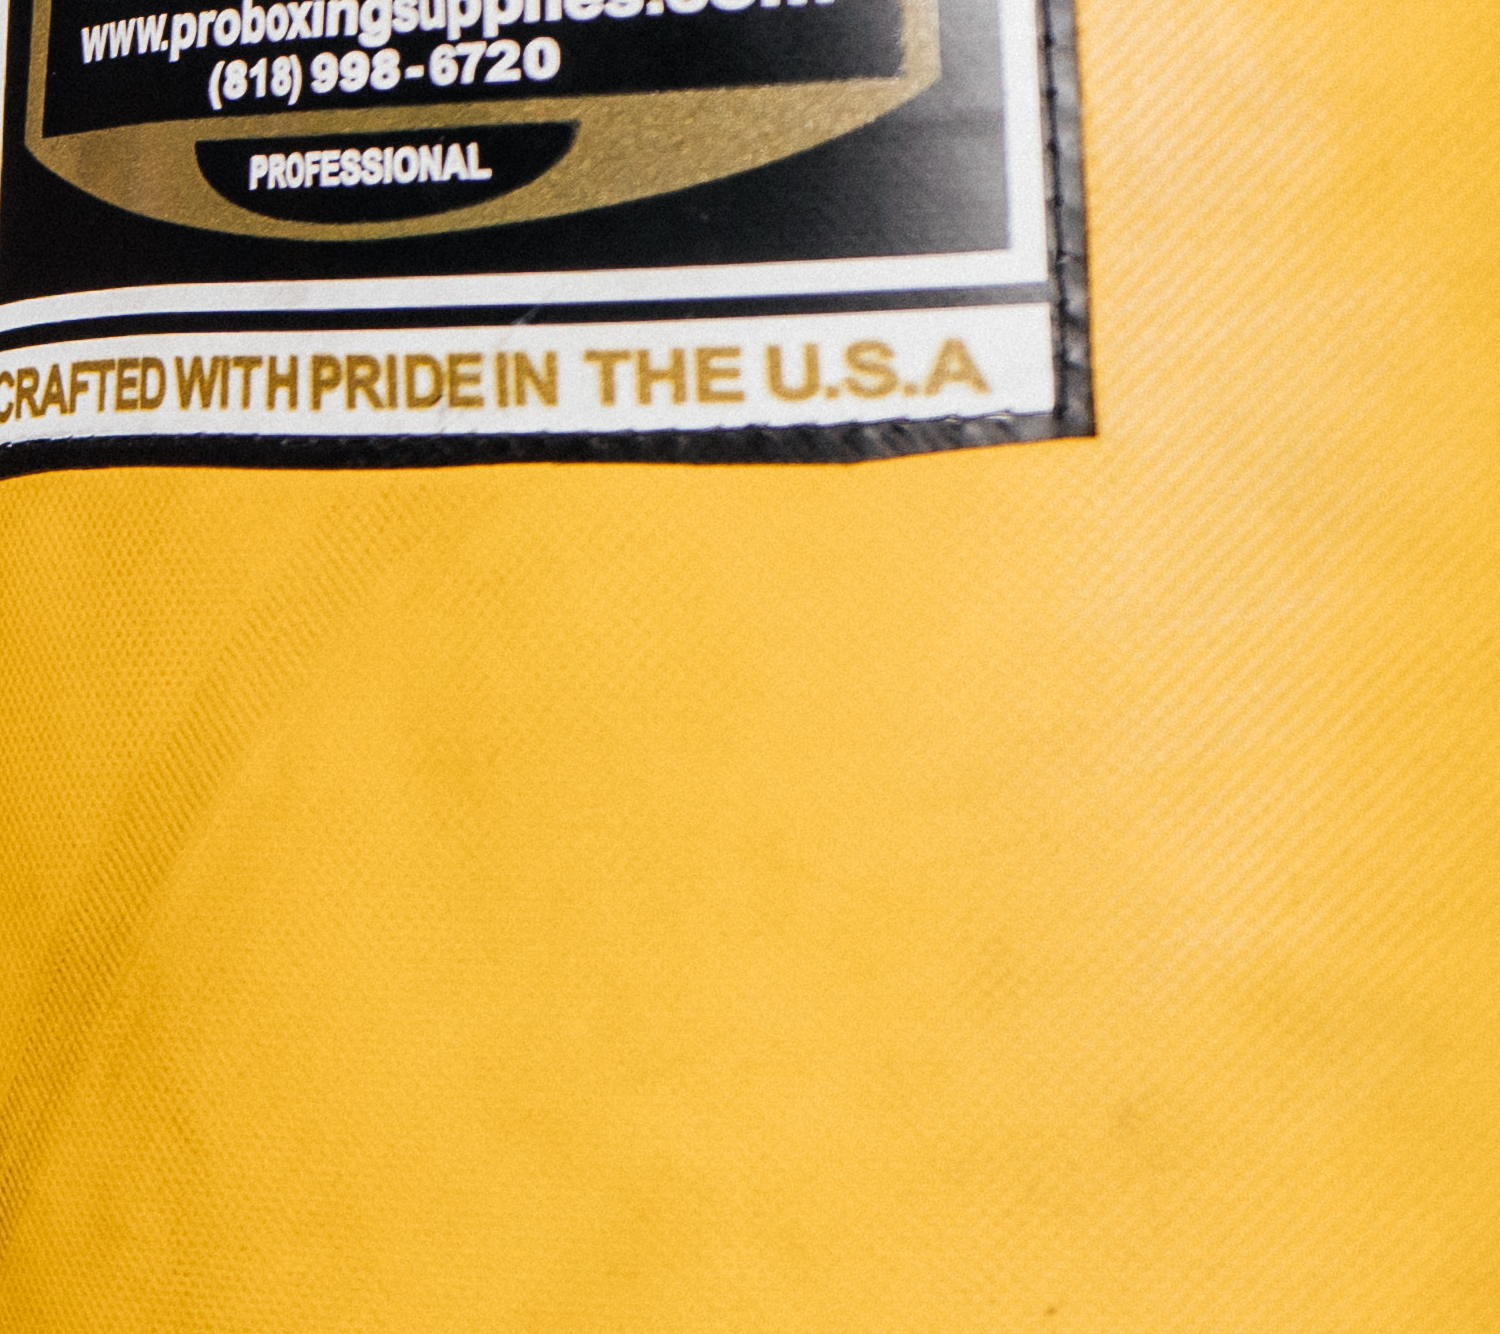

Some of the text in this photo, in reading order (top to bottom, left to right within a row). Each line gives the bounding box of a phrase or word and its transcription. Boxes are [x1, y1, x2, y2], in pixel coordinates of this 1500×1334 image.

[208, 36, 562, 110] (818) 998-6720
[248, 142, 493, 191] PROFESSIONAL
[175, 354, 298, 411] WITH
[310, 352, 484, 411] PRIDE
[495, 349, 558, 409] IN
[583, 346, 746, 406] THE
[764, 336, 992, 403] U.S.A
